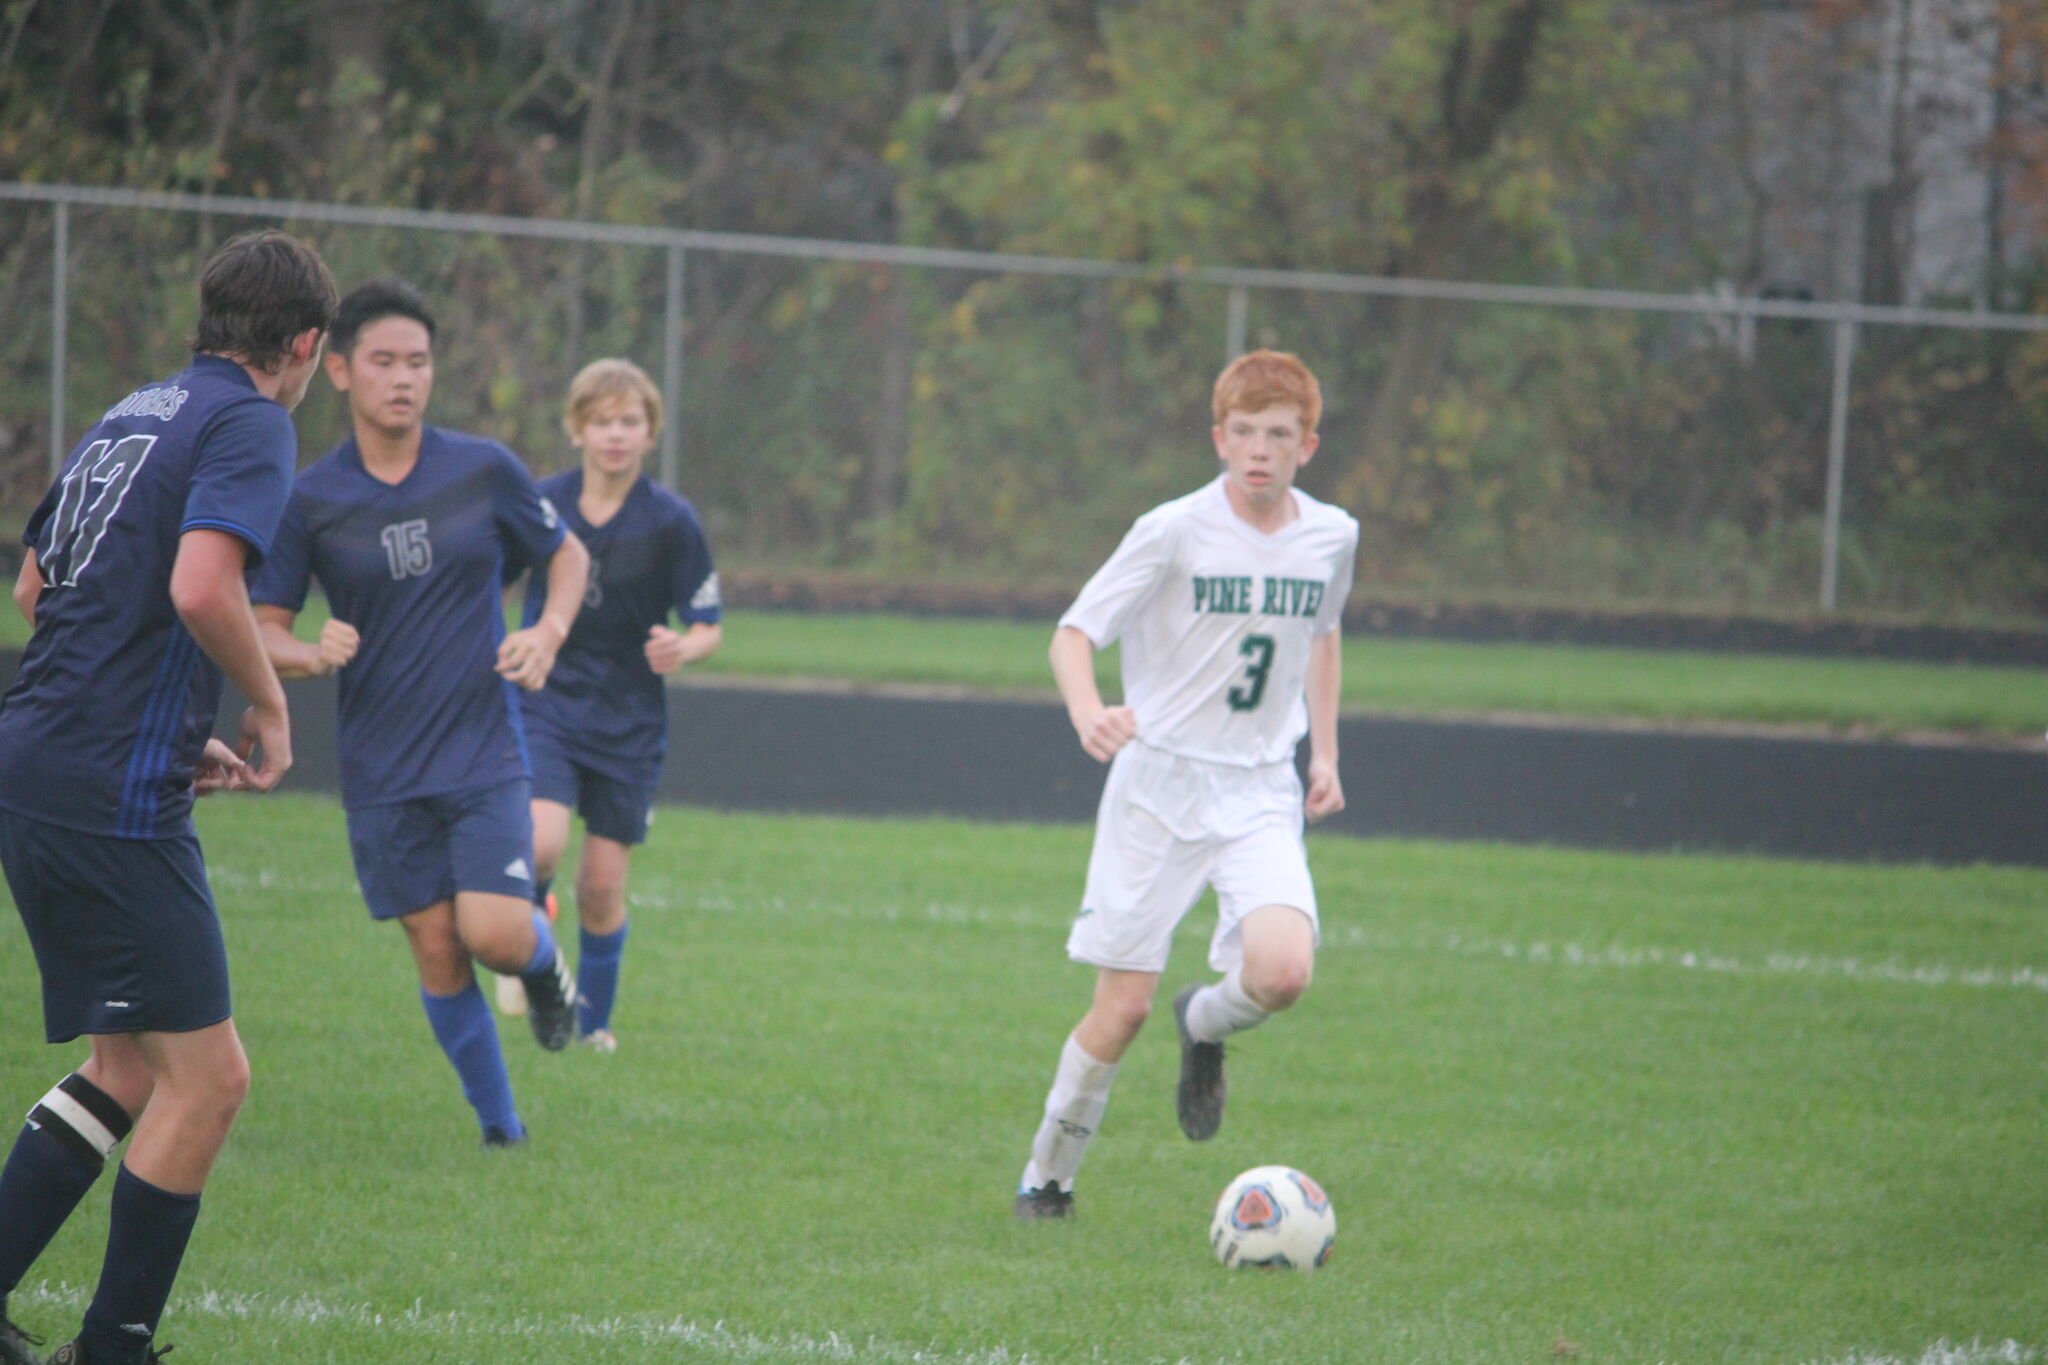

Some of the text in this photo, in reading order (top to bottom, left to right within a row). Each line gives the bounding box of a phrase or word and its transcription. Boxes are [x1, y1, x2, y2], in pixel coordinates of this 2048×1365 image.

[41, 434, 158, 587] 17
[380, 518, 432, 581] 15
[1193, 576, 1252, 614] PINE
[1228, 634, 1275, 711] 3
